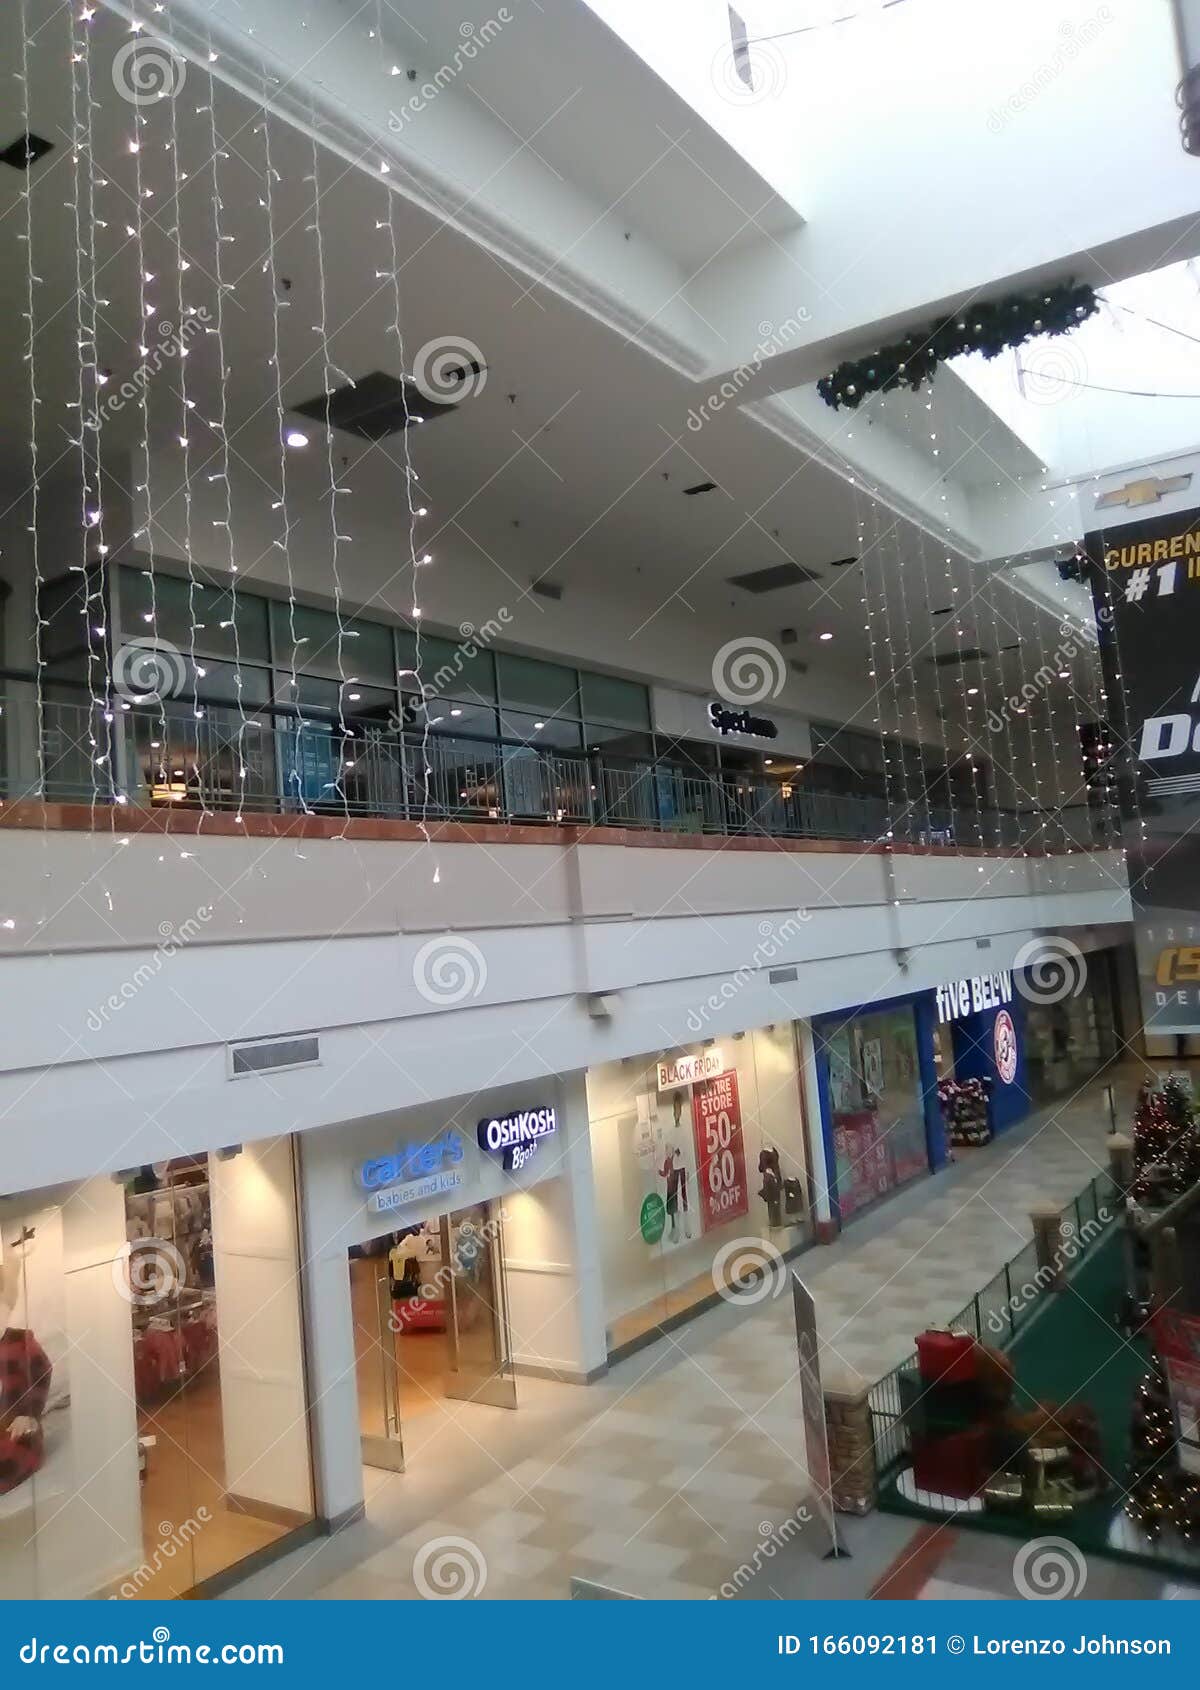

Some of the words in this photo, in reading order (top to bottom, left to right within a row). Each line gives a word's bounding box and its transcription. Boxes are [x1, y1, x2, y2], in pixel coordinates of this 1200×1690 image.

[1104, 532, 1200, 571] CURREN
[1125, 562, 1177, 602] #1
[936, 980, 970, 1024] five
[1155, 990, 1200, 1006] DE
[660, 1063, 692, 1085] BLACK
[701, 1095, 733, 1116] STORE
[487, 1108, 556, 1149] OSHKOSH
[361, 1130, 464, 1188] carter's
[708, 1150, 735, 1193] 60
[418, 1180, 437, 1196] and
[440, 1172, 461, 1190] kids
